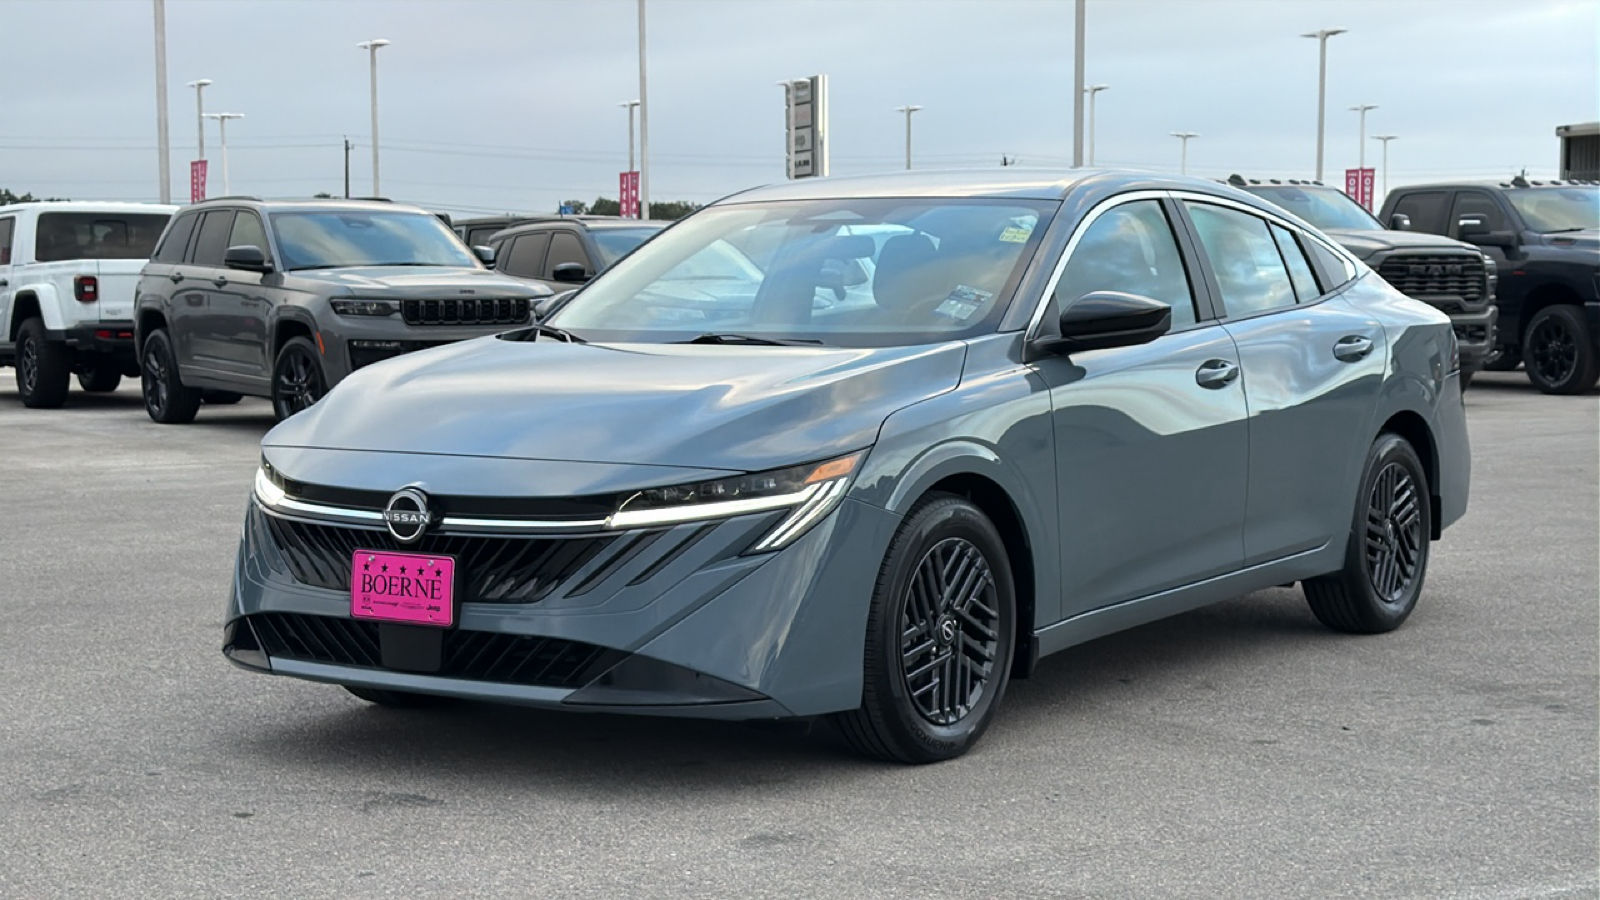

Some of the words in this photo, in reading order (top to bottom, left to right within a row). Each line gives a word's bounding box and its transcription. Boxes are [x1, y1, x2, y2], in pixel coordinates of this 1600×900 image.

[1409, 264, 1462, 275] RAM
[383, 511, 429, 524] NISSAN
[361, 573, 442, 600] BOERNE
